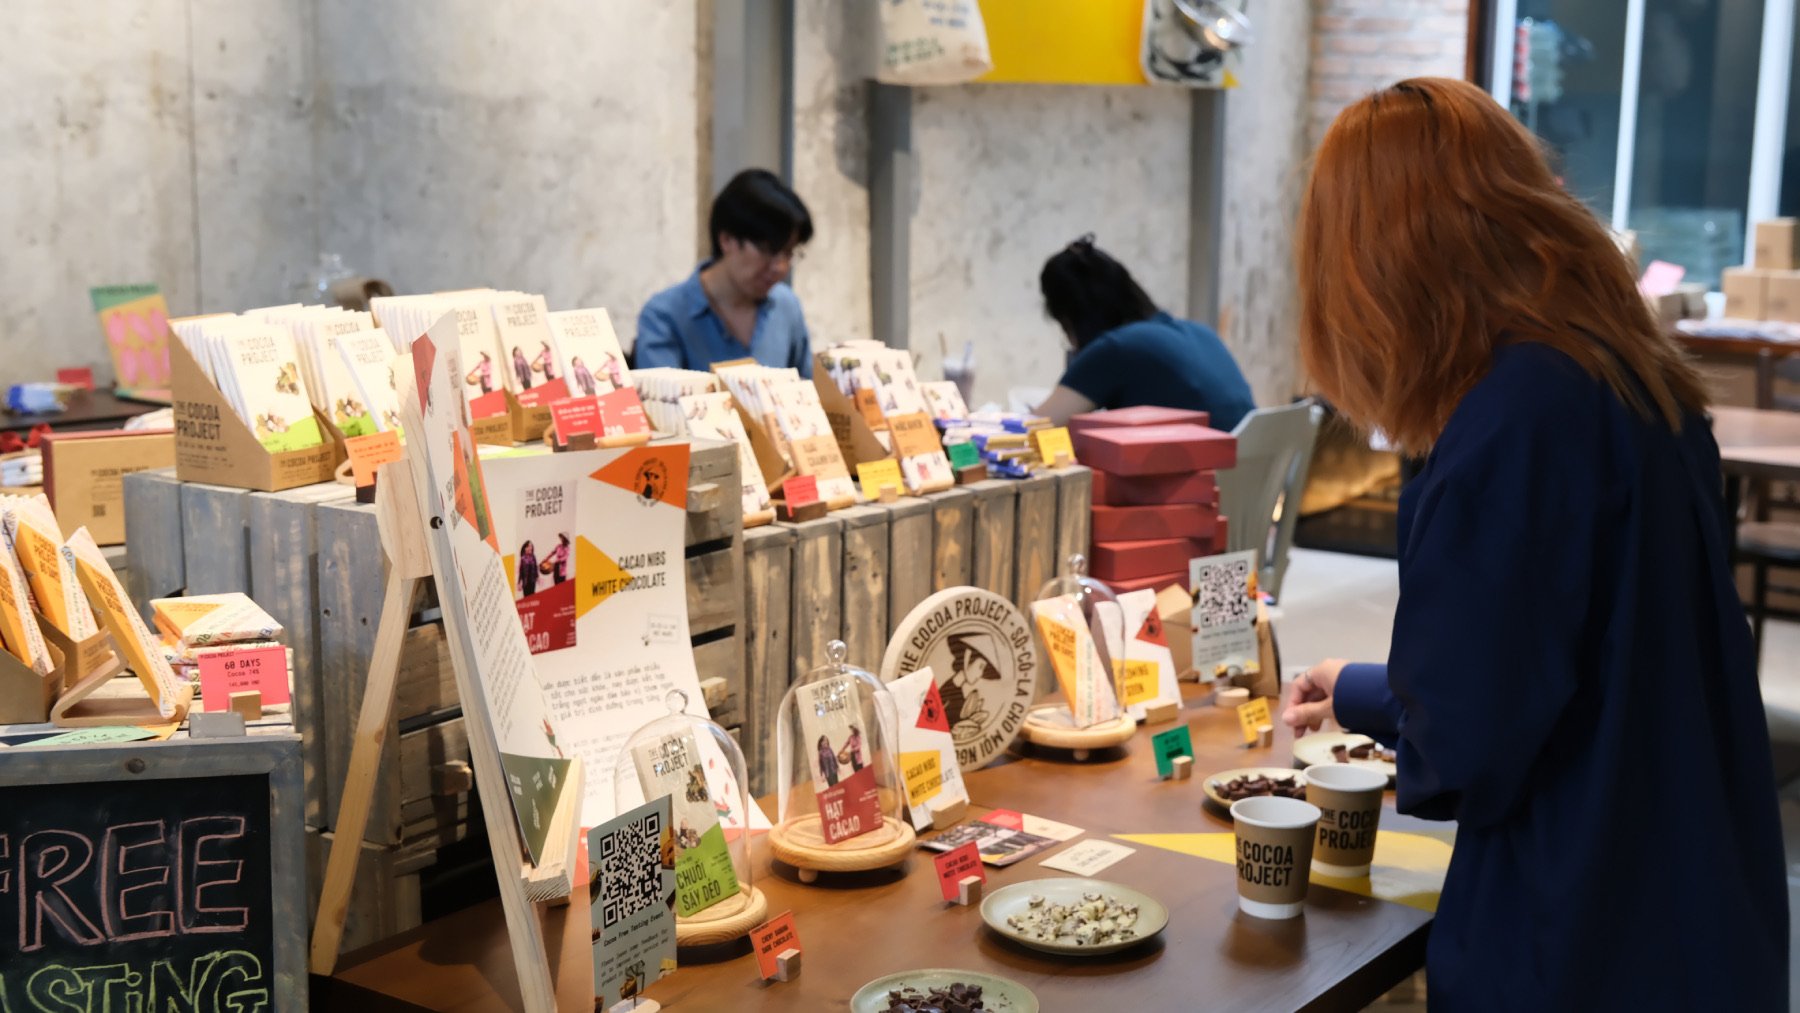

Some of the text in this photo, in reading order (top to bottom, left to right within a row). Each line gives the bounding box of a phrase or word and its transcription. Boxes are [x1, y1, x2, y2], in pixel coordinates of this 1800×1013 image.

[187, 401, 221, 420] COCOA
[176, 419, 222, 441] PROJECT
[535, 485, 564, 502] COCOA
[525, 500, 563, 519] PROJECT
[618, 551, 666, 571] CACAO NIBS
[592, 572, 667, 598] WHITE CHOCOLATE
[224, 658, 262, 670] 60 DAYS
[898, 650, 919, 679] HE
[912, 607, 953, 650] COCOA
[955, 597, 1011, 626] PROJECT
[1001, 701, 1025, 734] CHO
[652, 752, 688, 777] PROJECT
[1320, 806, 1336, 820] THE
[829, 815, 861, 841] CACAO
[1243, 839, 1294, 866] COCOA
